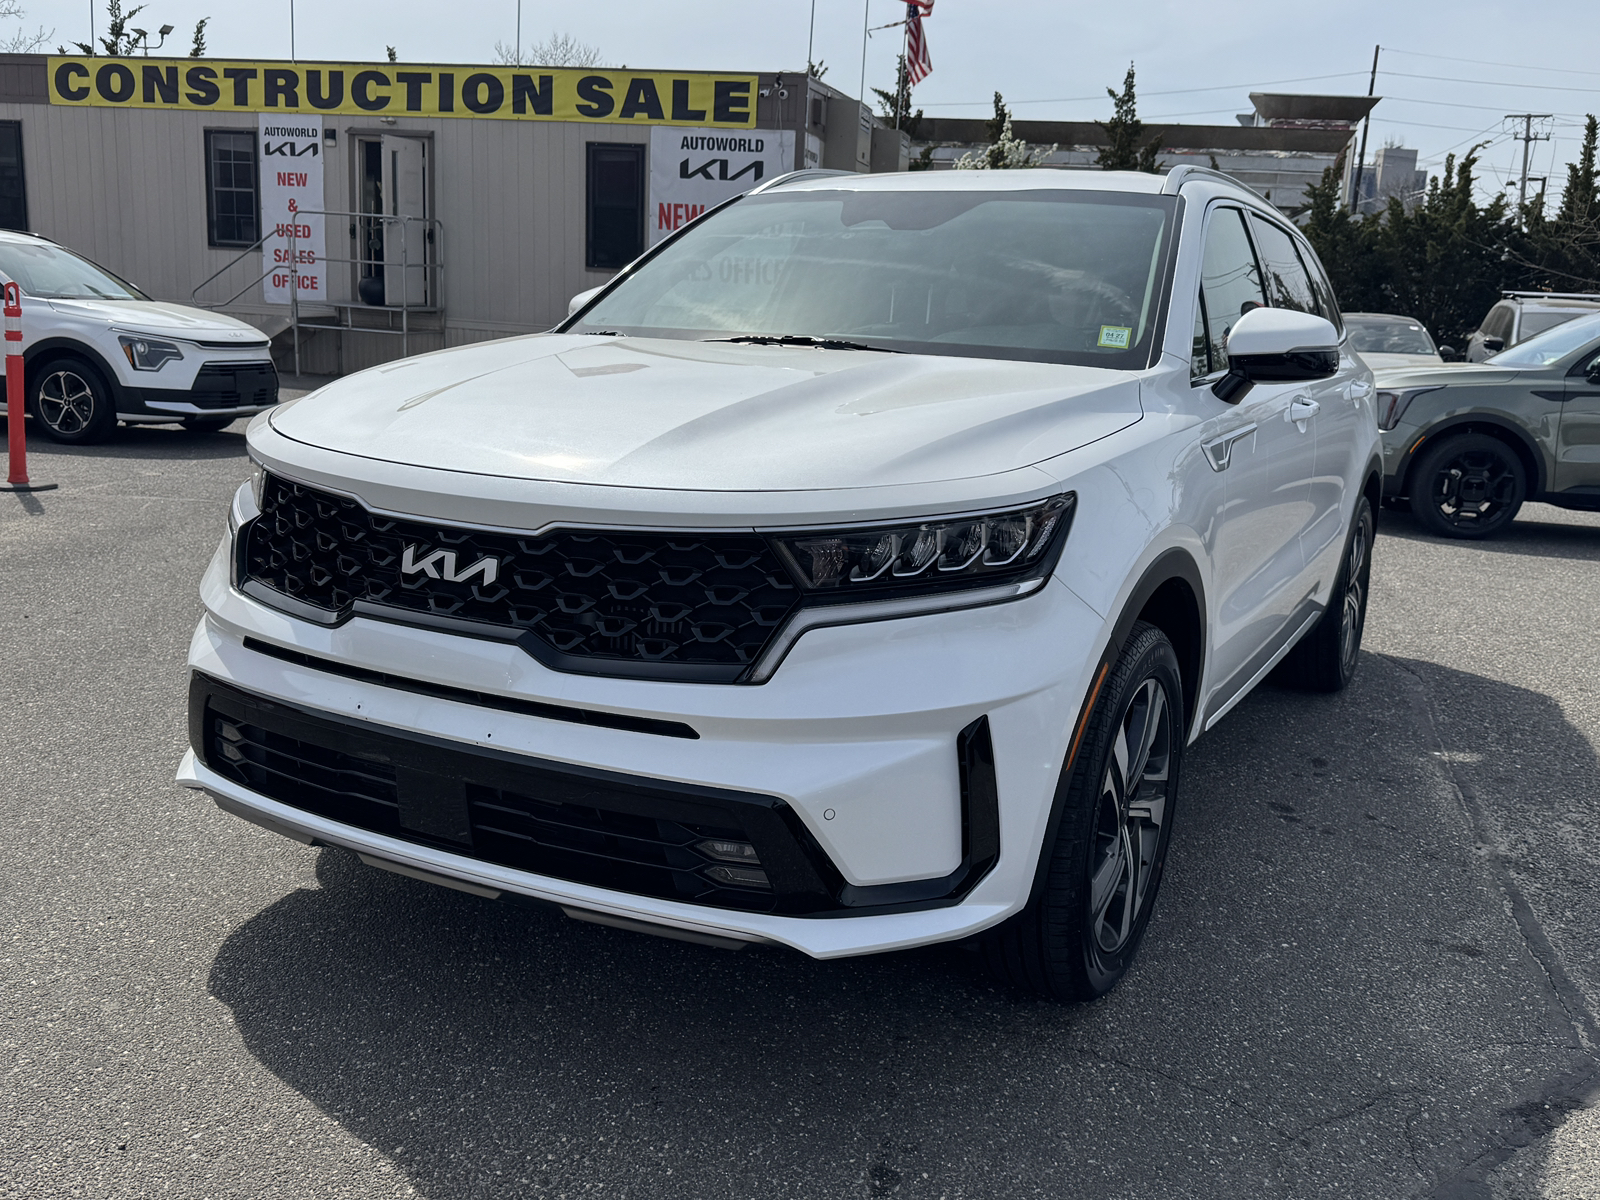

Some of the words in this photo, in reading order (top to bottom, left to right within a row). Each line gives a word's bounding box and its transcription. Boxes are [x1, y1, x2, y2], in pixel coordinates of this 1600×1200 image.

[54, 62, 553, 115] CONSTRUCTION
[575, 75, 751, 123] SALE
[264, 126, 318, 138] AUTOWORLD
[264, 141, 319, 157] KIA
[680, 136, 764, 153] AUTOWORLD
[679, 157, 764, 182] KIA
[277, 171, 308, 187] NEW
[288, 198, 298, 212] &
[276, 223, 311, 239] USED
[401, 543, 499, 587] KIA
